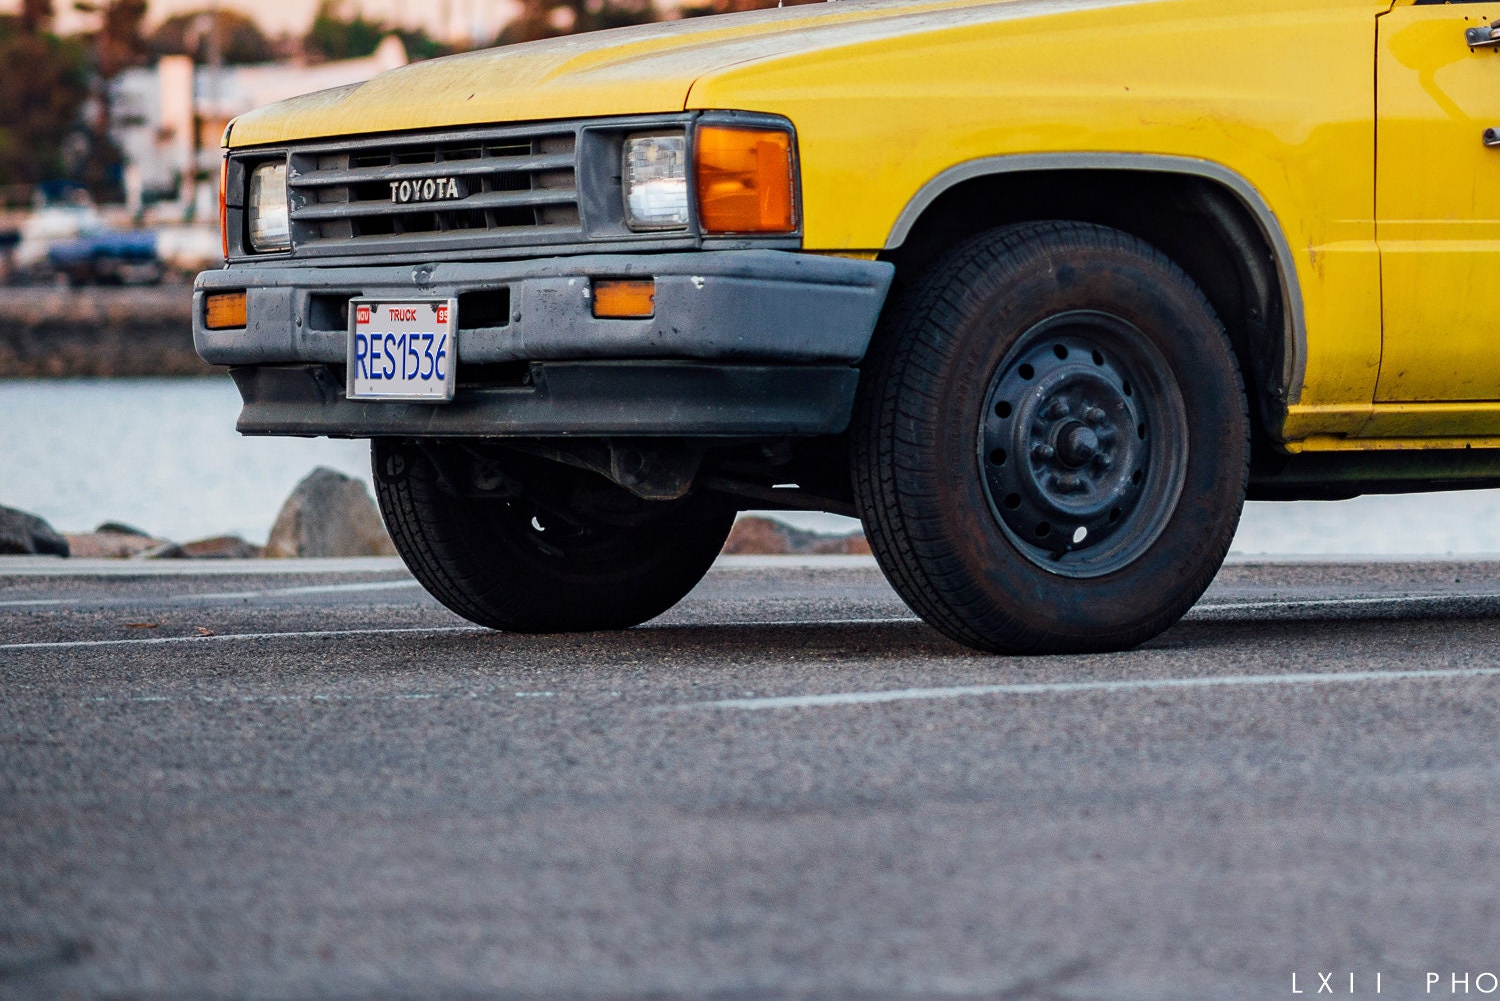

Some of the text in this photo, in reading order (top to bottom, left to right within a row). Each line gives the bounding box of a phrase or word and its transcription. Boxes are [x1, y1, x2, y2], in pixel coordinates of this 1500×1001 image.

[389, 178, 459, 202] TOYOTA
[389, 308, 416, 321] TRUCK
[355, 333, 447, 380] RES1536
